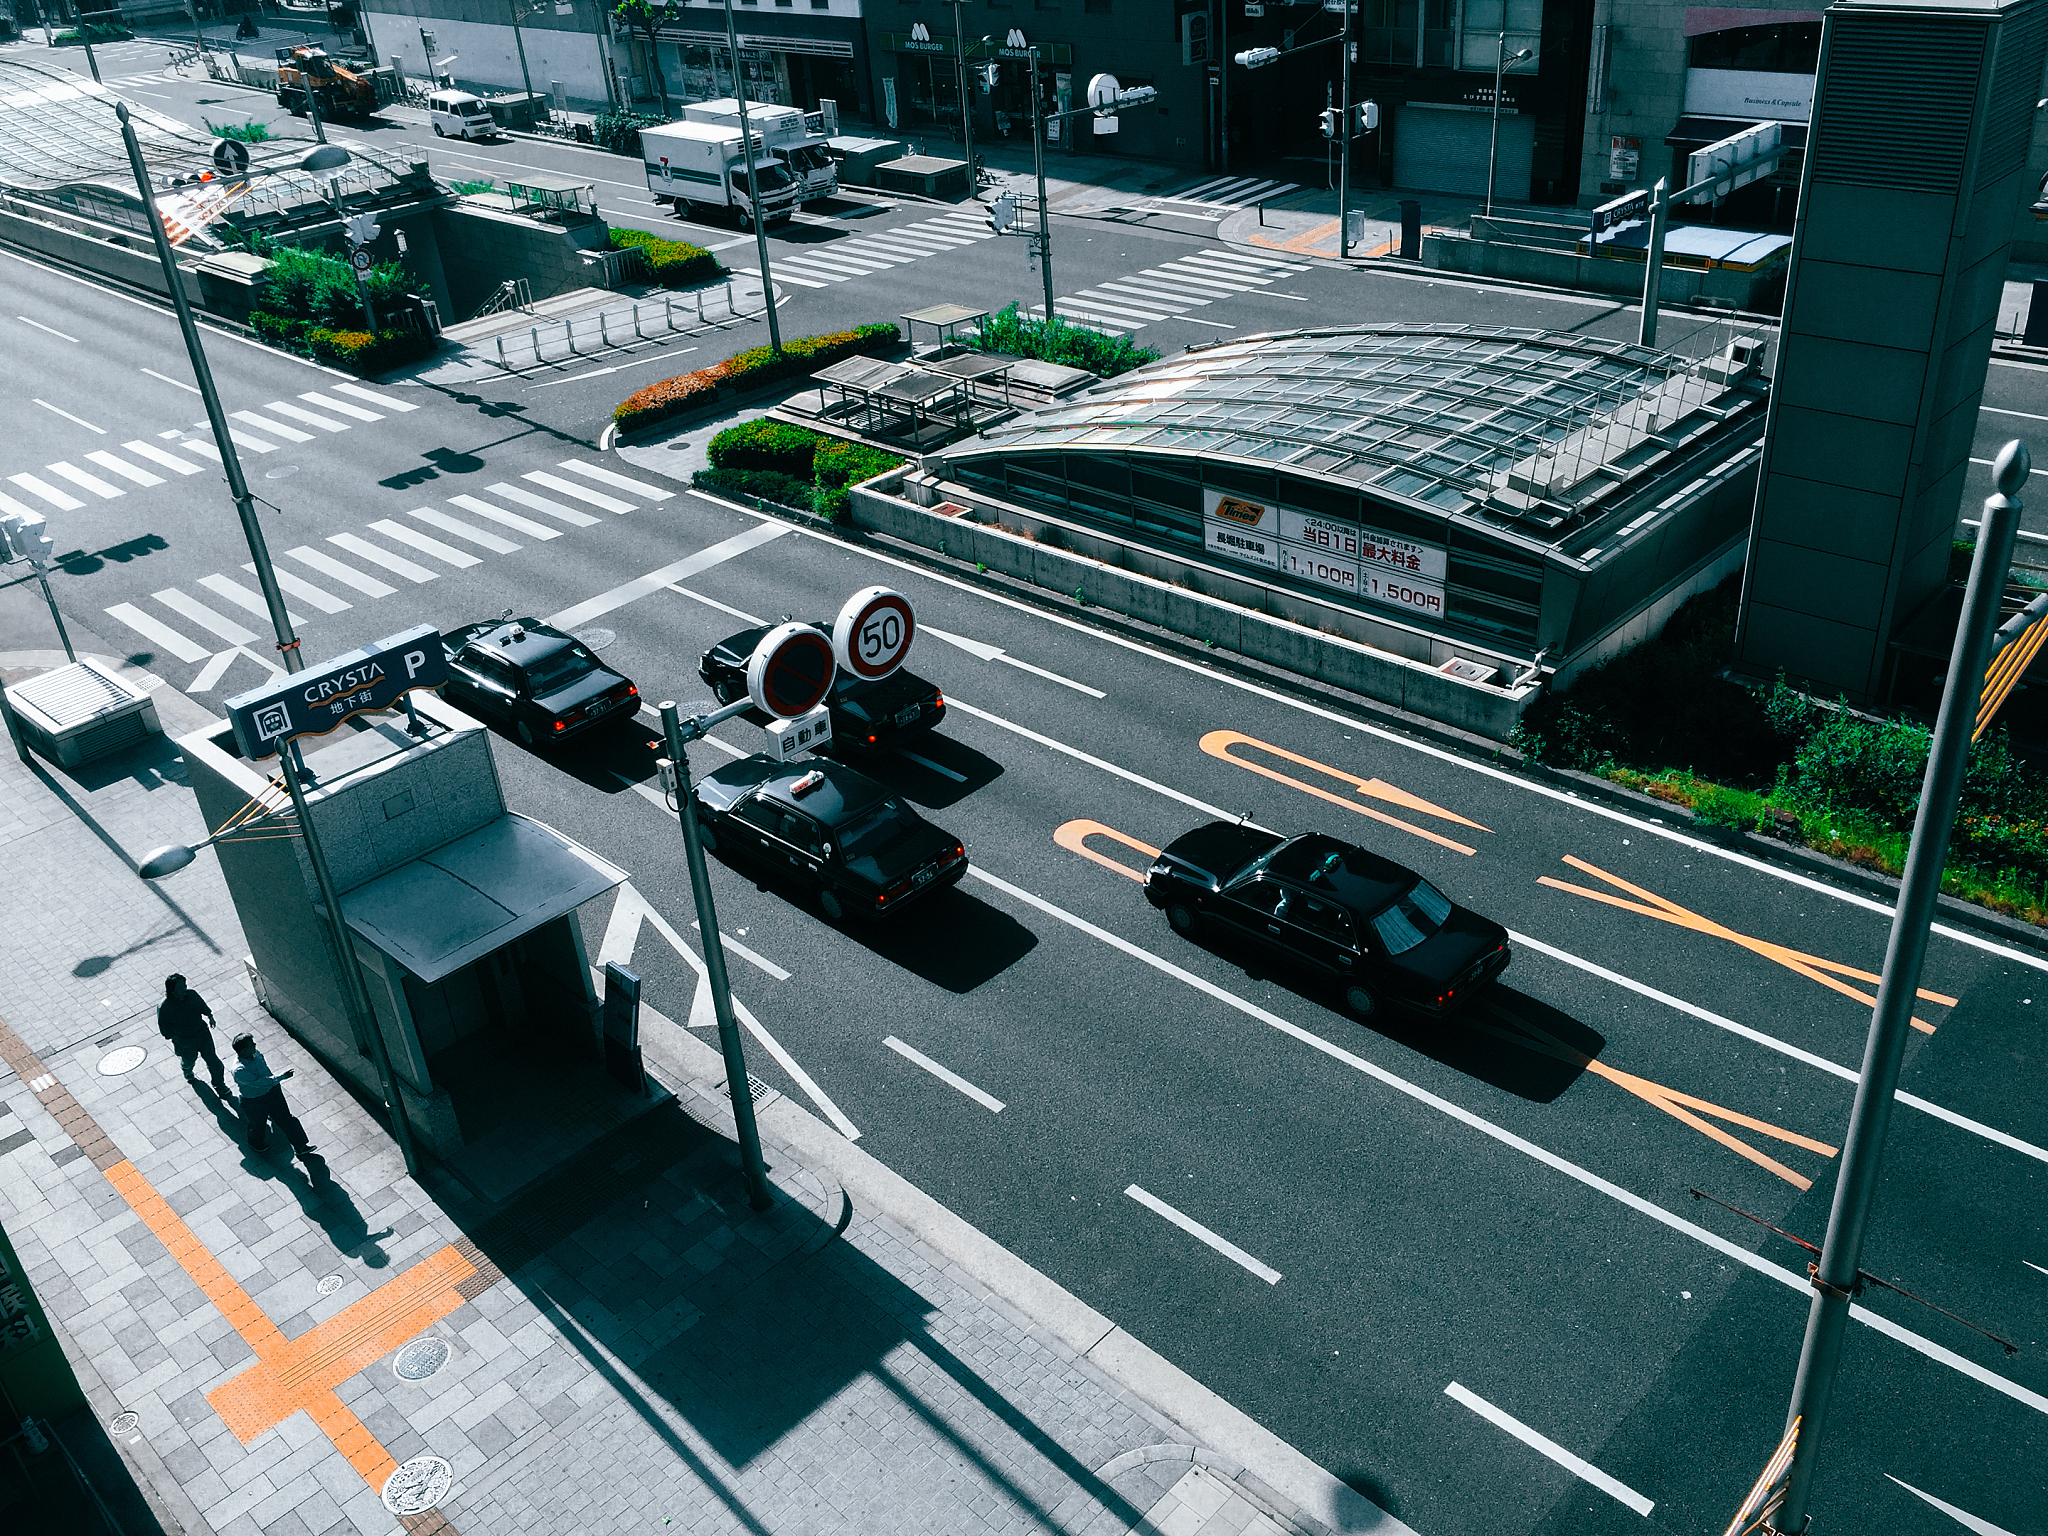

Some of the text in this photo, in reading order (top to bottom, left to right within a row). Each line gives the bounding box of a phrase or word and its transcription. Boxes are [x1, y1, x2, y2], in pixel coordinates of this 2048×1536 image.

[905, 41, 944, 51] MOS BURGER
[998, 48, 1041, 58] MOS BURGR
[1744, 97, 1770, 105] Business
[1777, 99, 1801, 107] Capsule
[1221, 500, 1258, 522] Times
[1216, 532, 1265, 556] 長堀駐車場
[1290, 556, 1355, 587] 1,100円
[1371, 578, 1441, 612] 1,500円
[863, 615, 900, 659] 50
[304, 650, 426, 703] CRYSTA P
[330, 689, 373, 716] 地下街
[782, 720, 829, 754] 自動車
